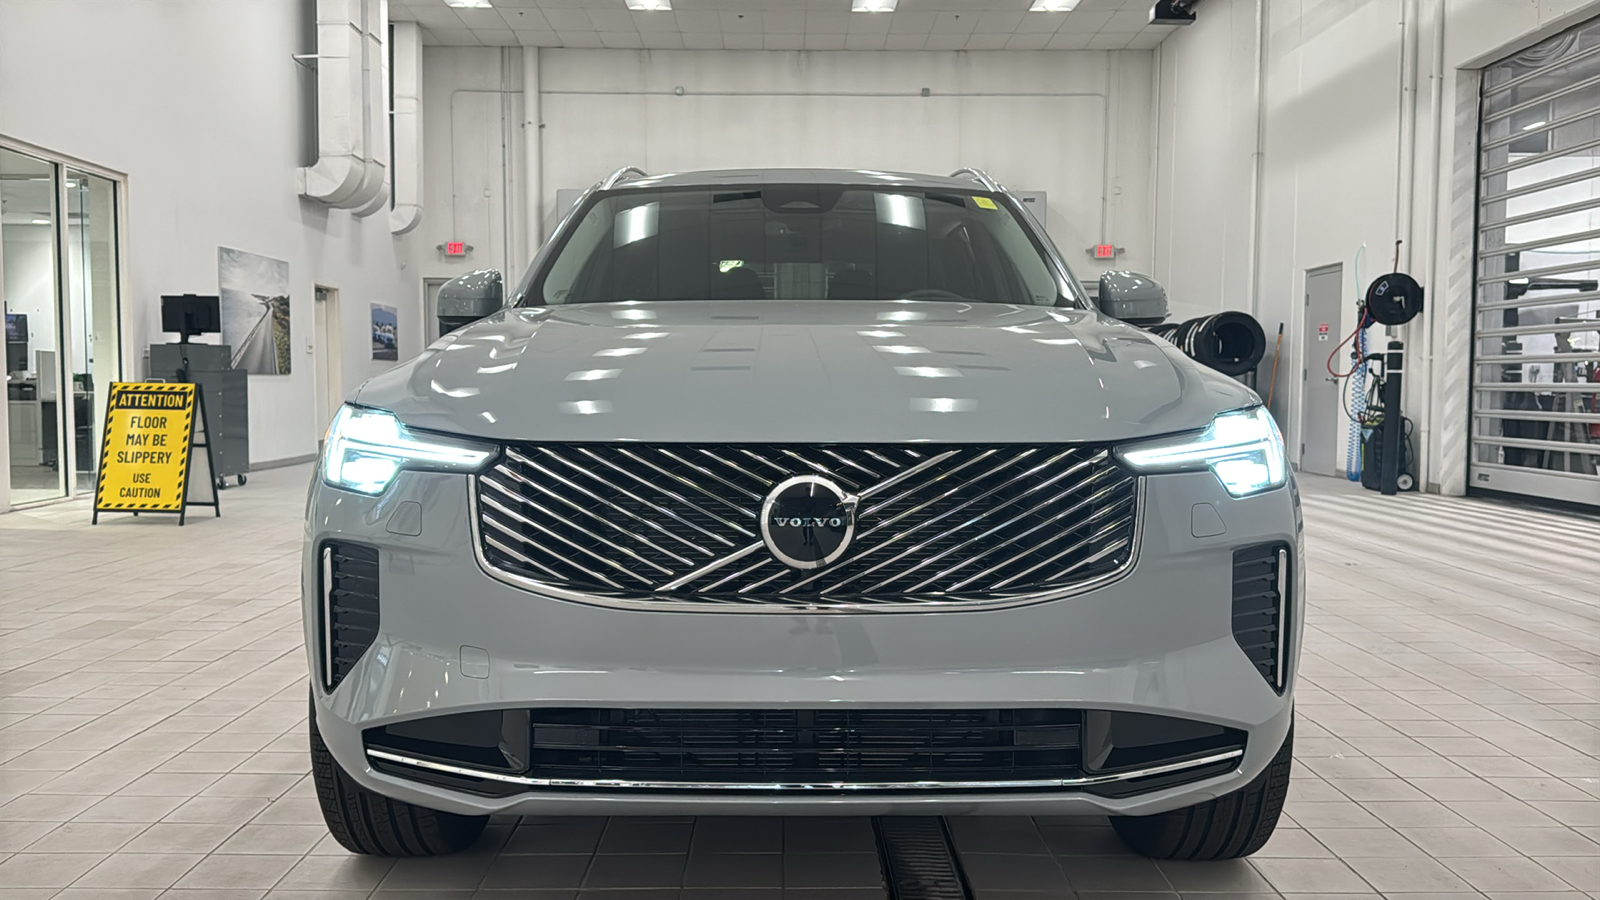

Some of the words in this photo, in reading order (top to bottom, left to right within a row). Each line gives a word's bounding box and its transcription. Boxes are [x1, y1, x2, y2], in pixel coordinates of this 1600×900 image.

[118, 393, 184, 408] ATTENTION
[130, 416, 167, 429] FLOOR
[126, 434, 149, 446] MAY
[152, 434, 168, 446] BE
[117, 451, 172, 464] SLIPPERY
[132, 473, 151, 484] USE
[119, 487, 161, 498] CAUTION
[774, 517, 841, 527] VOLVO
